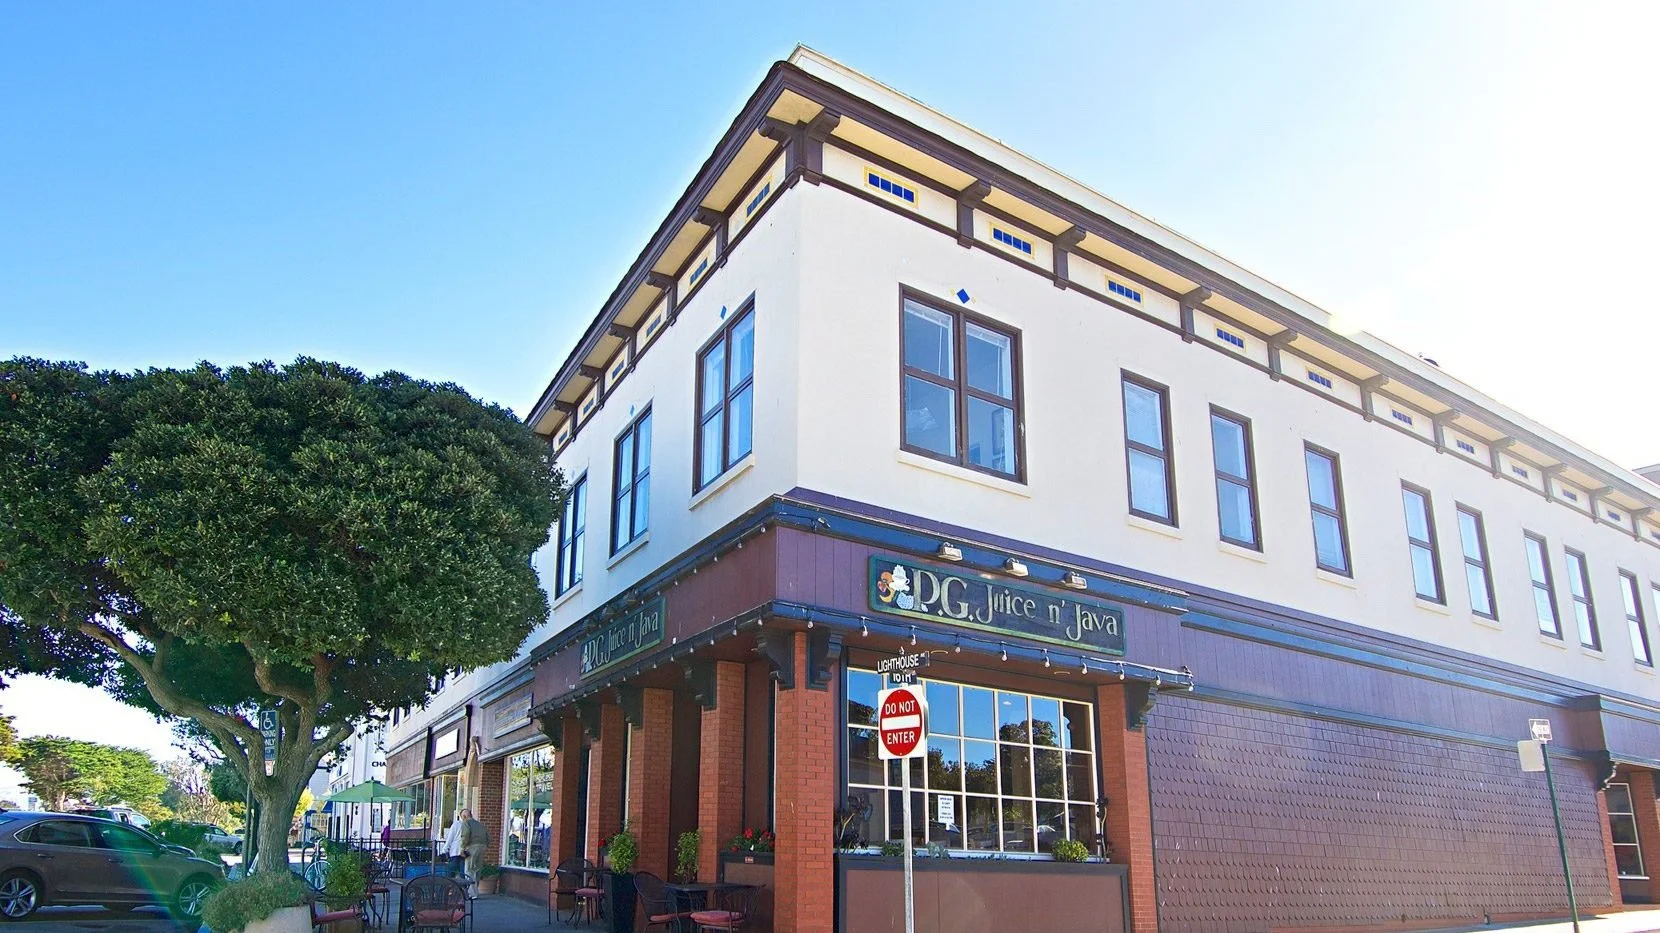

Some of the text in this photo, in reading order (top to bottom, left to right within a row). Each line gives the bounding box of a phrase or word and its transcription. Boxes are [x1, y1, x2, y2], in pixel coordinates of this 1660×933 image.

[911, 568, 974, 621] P.G.
[976, 584, 1036, 624] Juice
[1066, 604, 1118, 641] Java
[604, 627, 626, 663] Juice
[634, 611, 658, 648] Java
[877, 654, 919, 672] LIGHTHOUSE
[885, 700, 915, 714] DO NOT
[887, 731, 915, 745] ENTER
